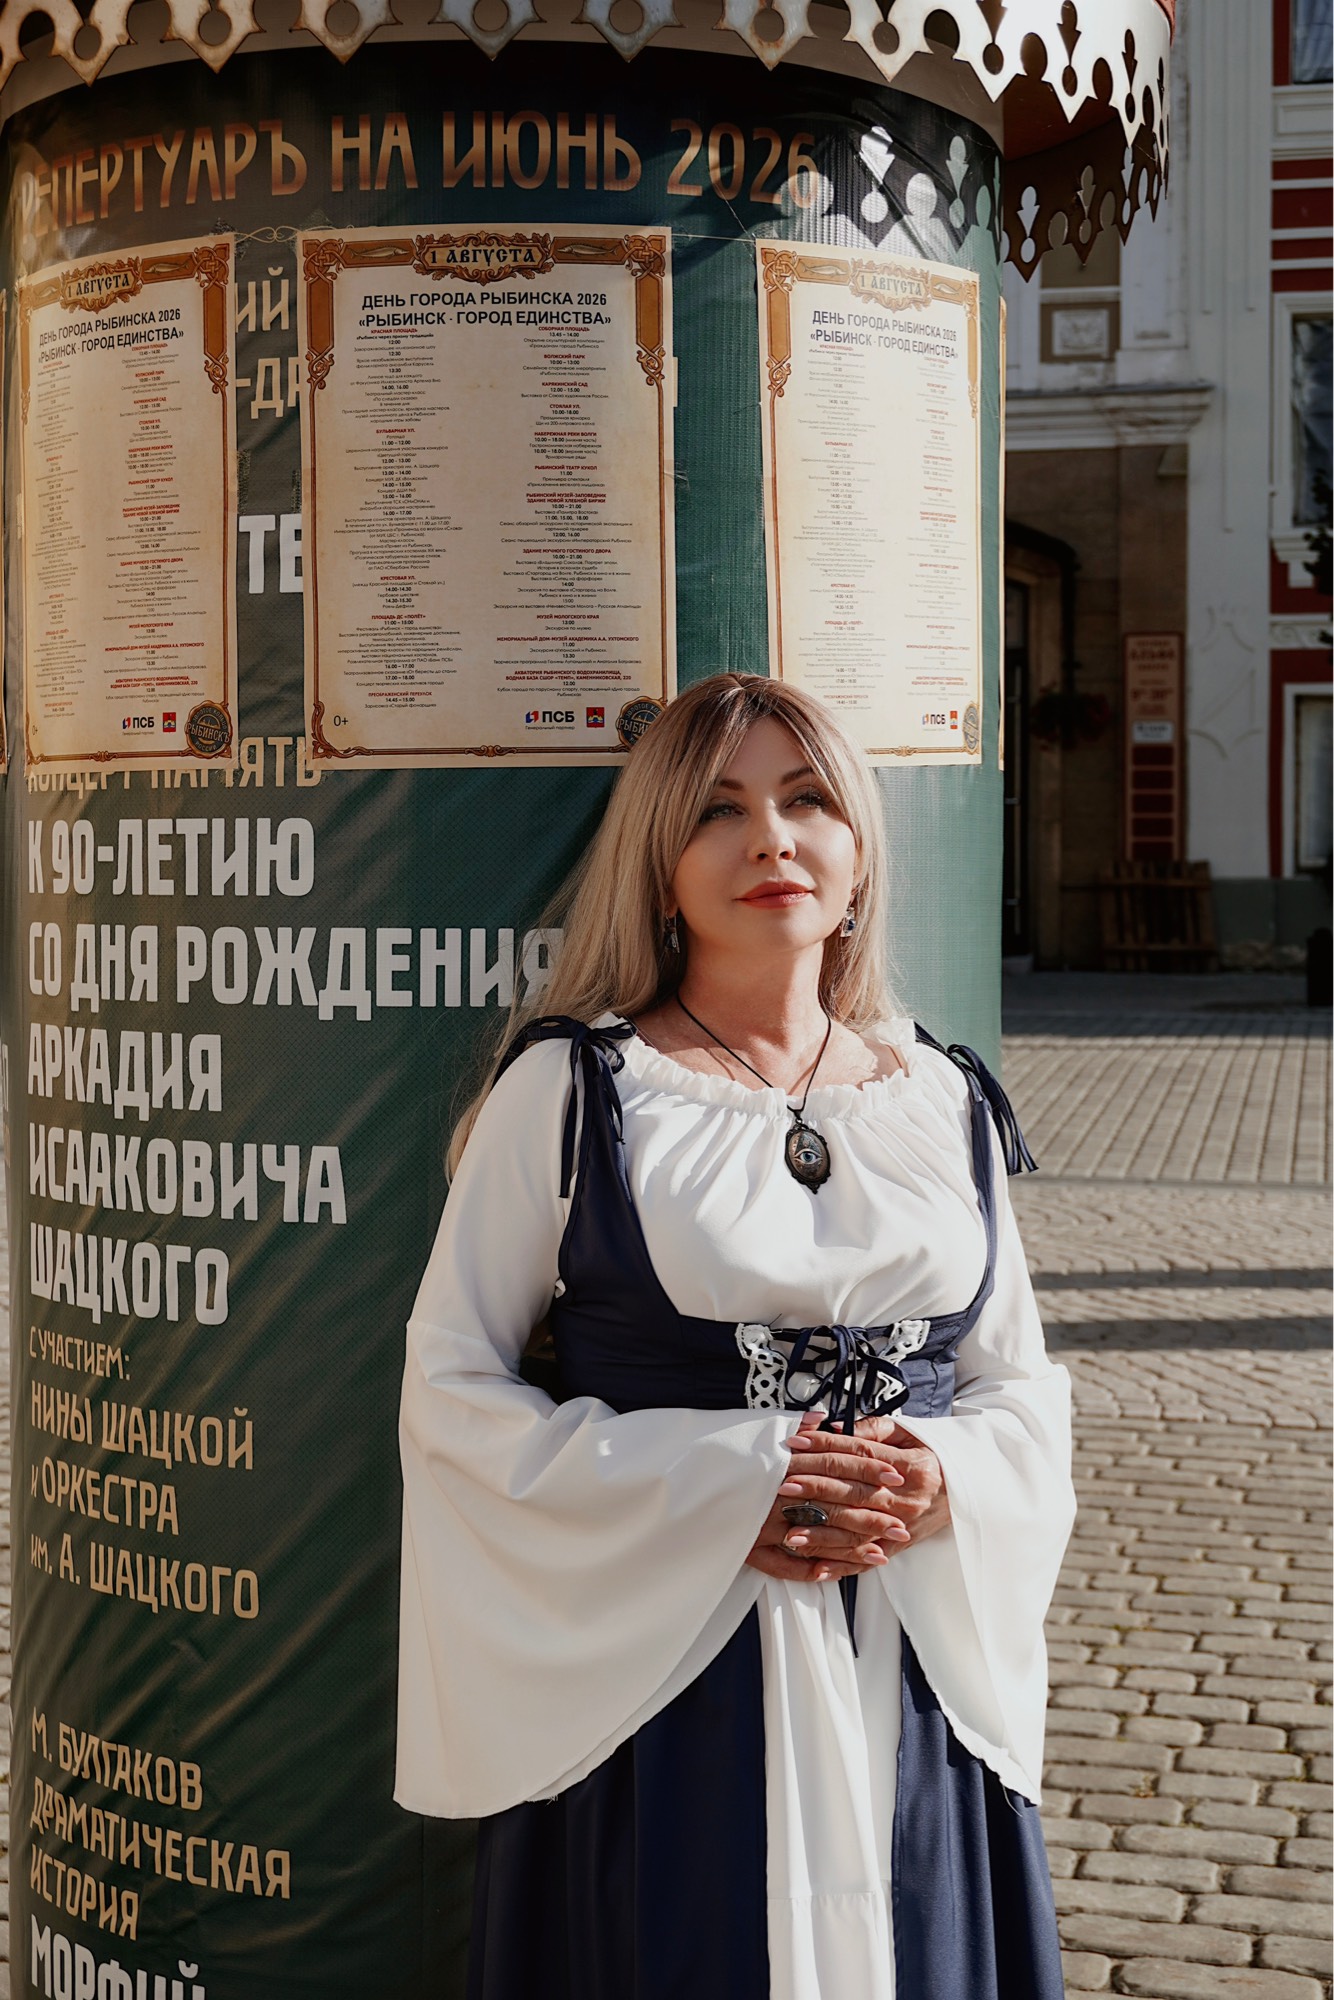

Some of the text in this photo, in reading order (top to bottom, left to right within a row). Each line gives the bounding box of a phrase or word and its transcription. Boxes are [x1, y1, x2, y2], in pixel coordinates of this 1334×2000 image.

[22, 110, 819, 245] РЕПЕРТУАРЪ НА ИЮНЬ 2026
[431, 248, 536, 266] 1 АВГУСТА
[67, 273, 130, 298] 1 АВГУСТА
[362, 292, 607, 310] ДЕНЬ ГОРОДА РЫБИНСКА 2026
[860, 275, 922, 296] 1 АВГУСТА
[40, 308, 181, 347] ДЕНЬ ГОРОДА РЫБИНСКА 2026
[359, 312, 446, 328] «РЫБИНСК
[456, 312, 512, 326] ГОРОД
[516, 311, 612, 326] ЕДИНСТВА»
[812, 310, 957, 342] ДЕНЬ ГОРОДА РЫБИНСКА 2026
[38, 344, 76, 364] «РЫБИНСК
[82, 336, 115, 352] ГОРОД
[117, 326, 184, 348] ЕДИНСТВА»
[810, 329, 872, 346] «РЫБИНСК
[878, 335, 911, 352] ГОРОД
[912, 340, 958, 359] ЕДИНСТВА»
[132, 716, 154, 728] ПСБ
[188, 724, 230, 743] РЫБИНСКЪ
[333, 715, 348, 726] 0+
[542, 710, 575, 722] ПСБ
[930, 714, 946, 725] ПСБ
[28, 817, 315, 897] К 90-ЛЕТИЮ
[28, 922, 563, 1021] СО ДНЯ РОЖДЕНИЯ
[28, 1022, 222, 1122] АРКАДИЯ
[29, 1122, 348, 1225] ИСААКОВИЧА
[30, 1222, 230, 1326] ШАЦКОГО
[38, 1332, 131, 1381] УЧАСТИЕМ:
[31, 1380, 254, 1470] НИНЫ ШАЦКОЙ
[42, 1456, 180, 1536] ОРКЕСТРА
[59, 1532, 80, 1585] А.
[90, 1541, 260, 1620] ШАЦКОГО
[32, 1706, 204, 1812] М. БУЛГАКОВ
[30, 1776, 292, 1900] ДРАМАТИЧЕСКАЯ
[31, 1843, 139, 1942] ИСТОРИЯ
